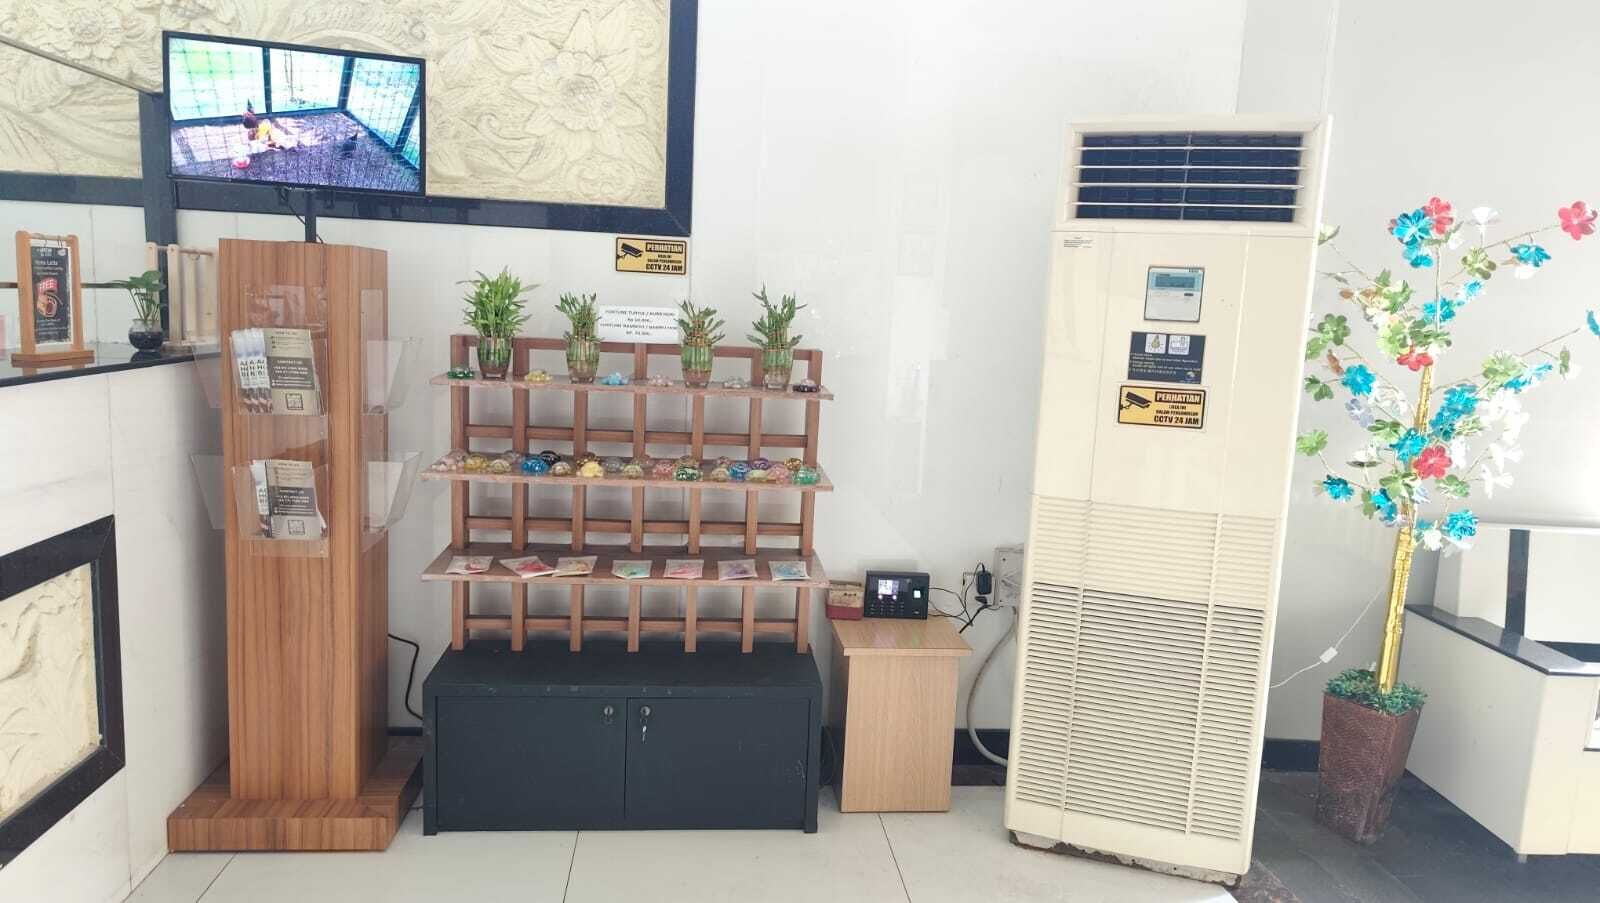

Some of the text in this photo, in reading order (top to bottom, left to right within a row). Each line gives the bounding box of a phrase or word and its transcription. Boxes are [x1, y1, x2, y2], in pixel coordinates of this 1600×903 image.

[647, 243, 683, 253] PERHATIAN
[1156, 393, 1201, 404] PERHATIAN
[1154, 416, 1199, 425] CCTV 24 JAM
